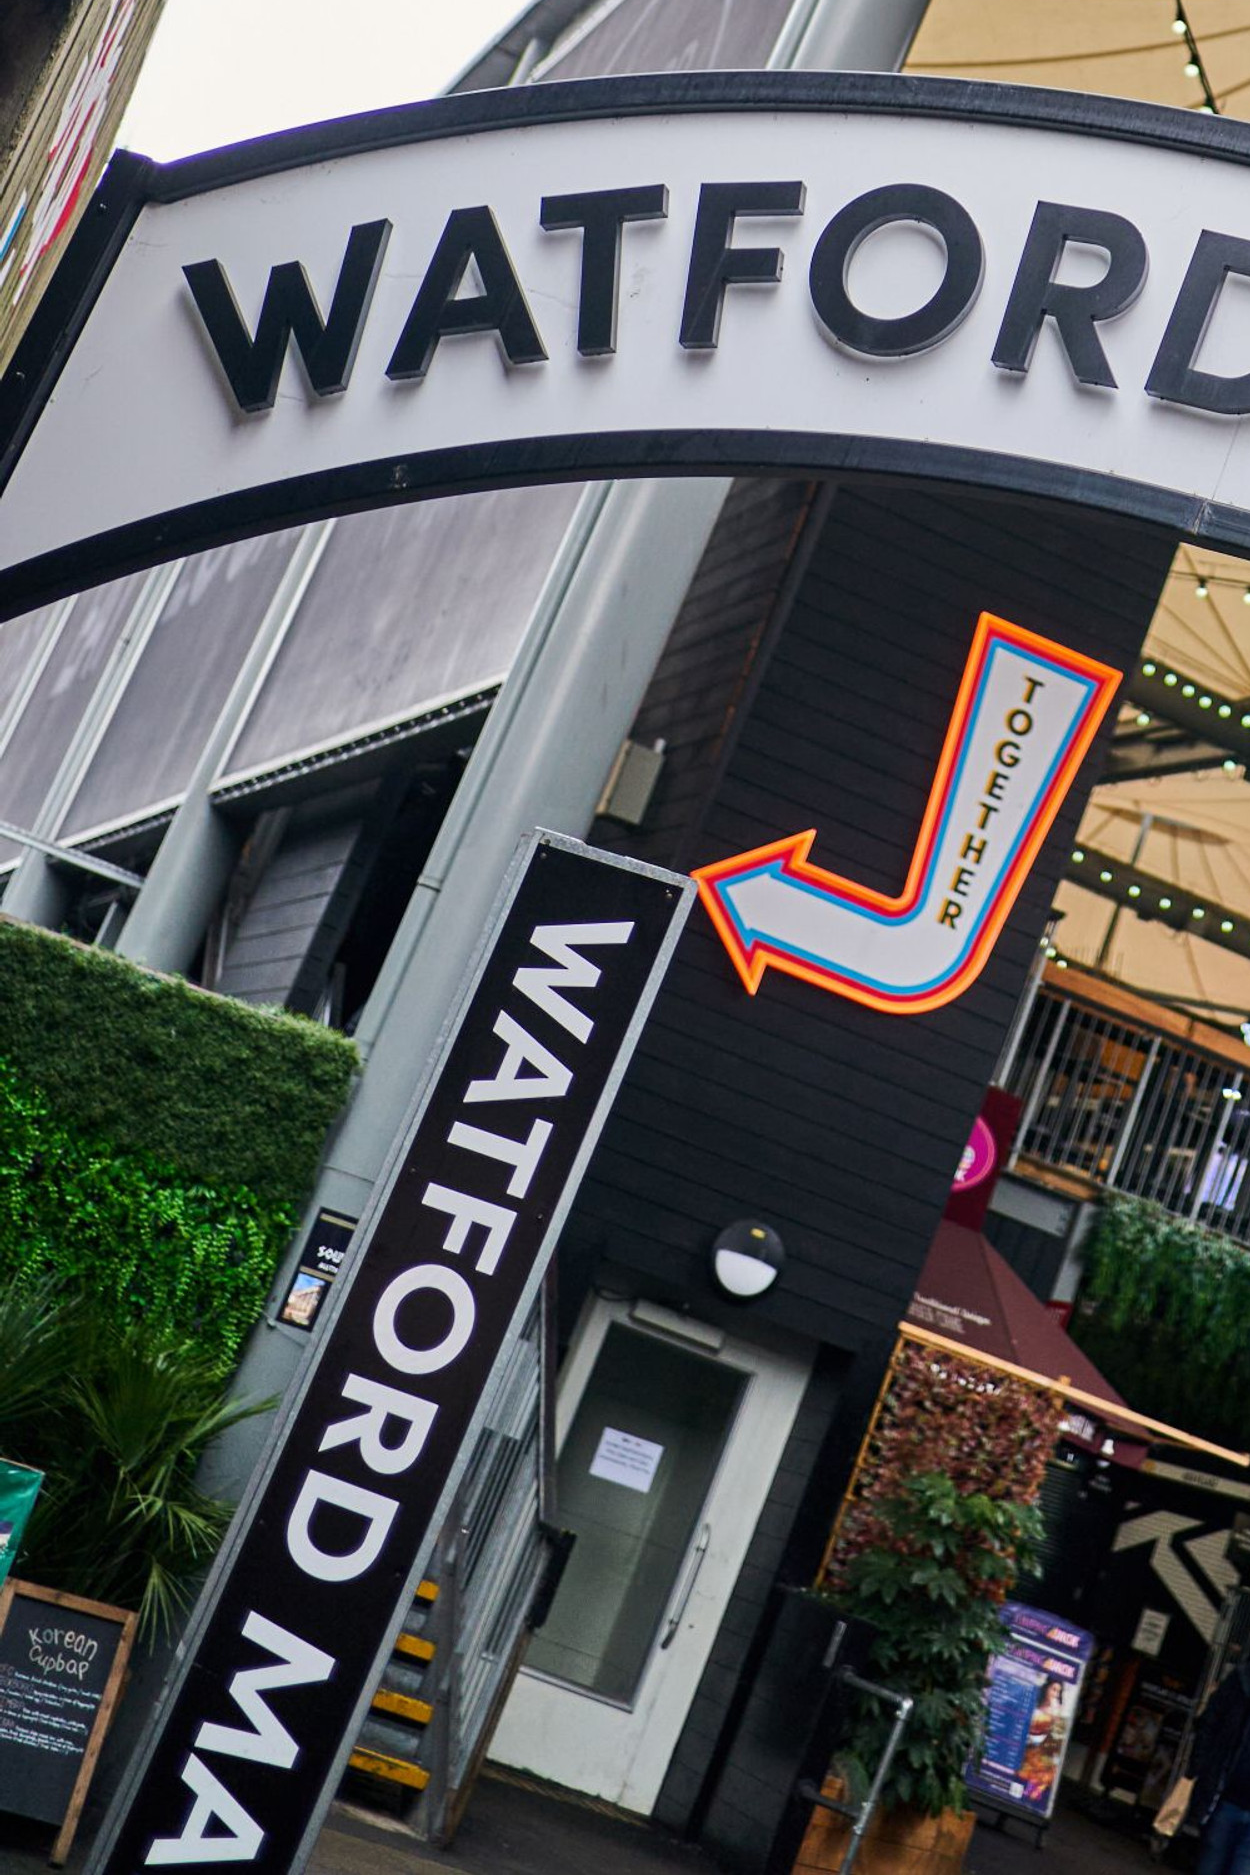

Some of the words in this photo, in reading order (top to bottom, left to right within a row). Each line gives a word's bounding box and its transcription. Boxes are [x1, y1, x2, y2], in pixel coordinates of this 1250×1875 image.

[935, 676, 1046, 930] TOGETHER
[286, 921, 635, 1582] WATFORD
[29, 1627, 98, 1661] Korean
